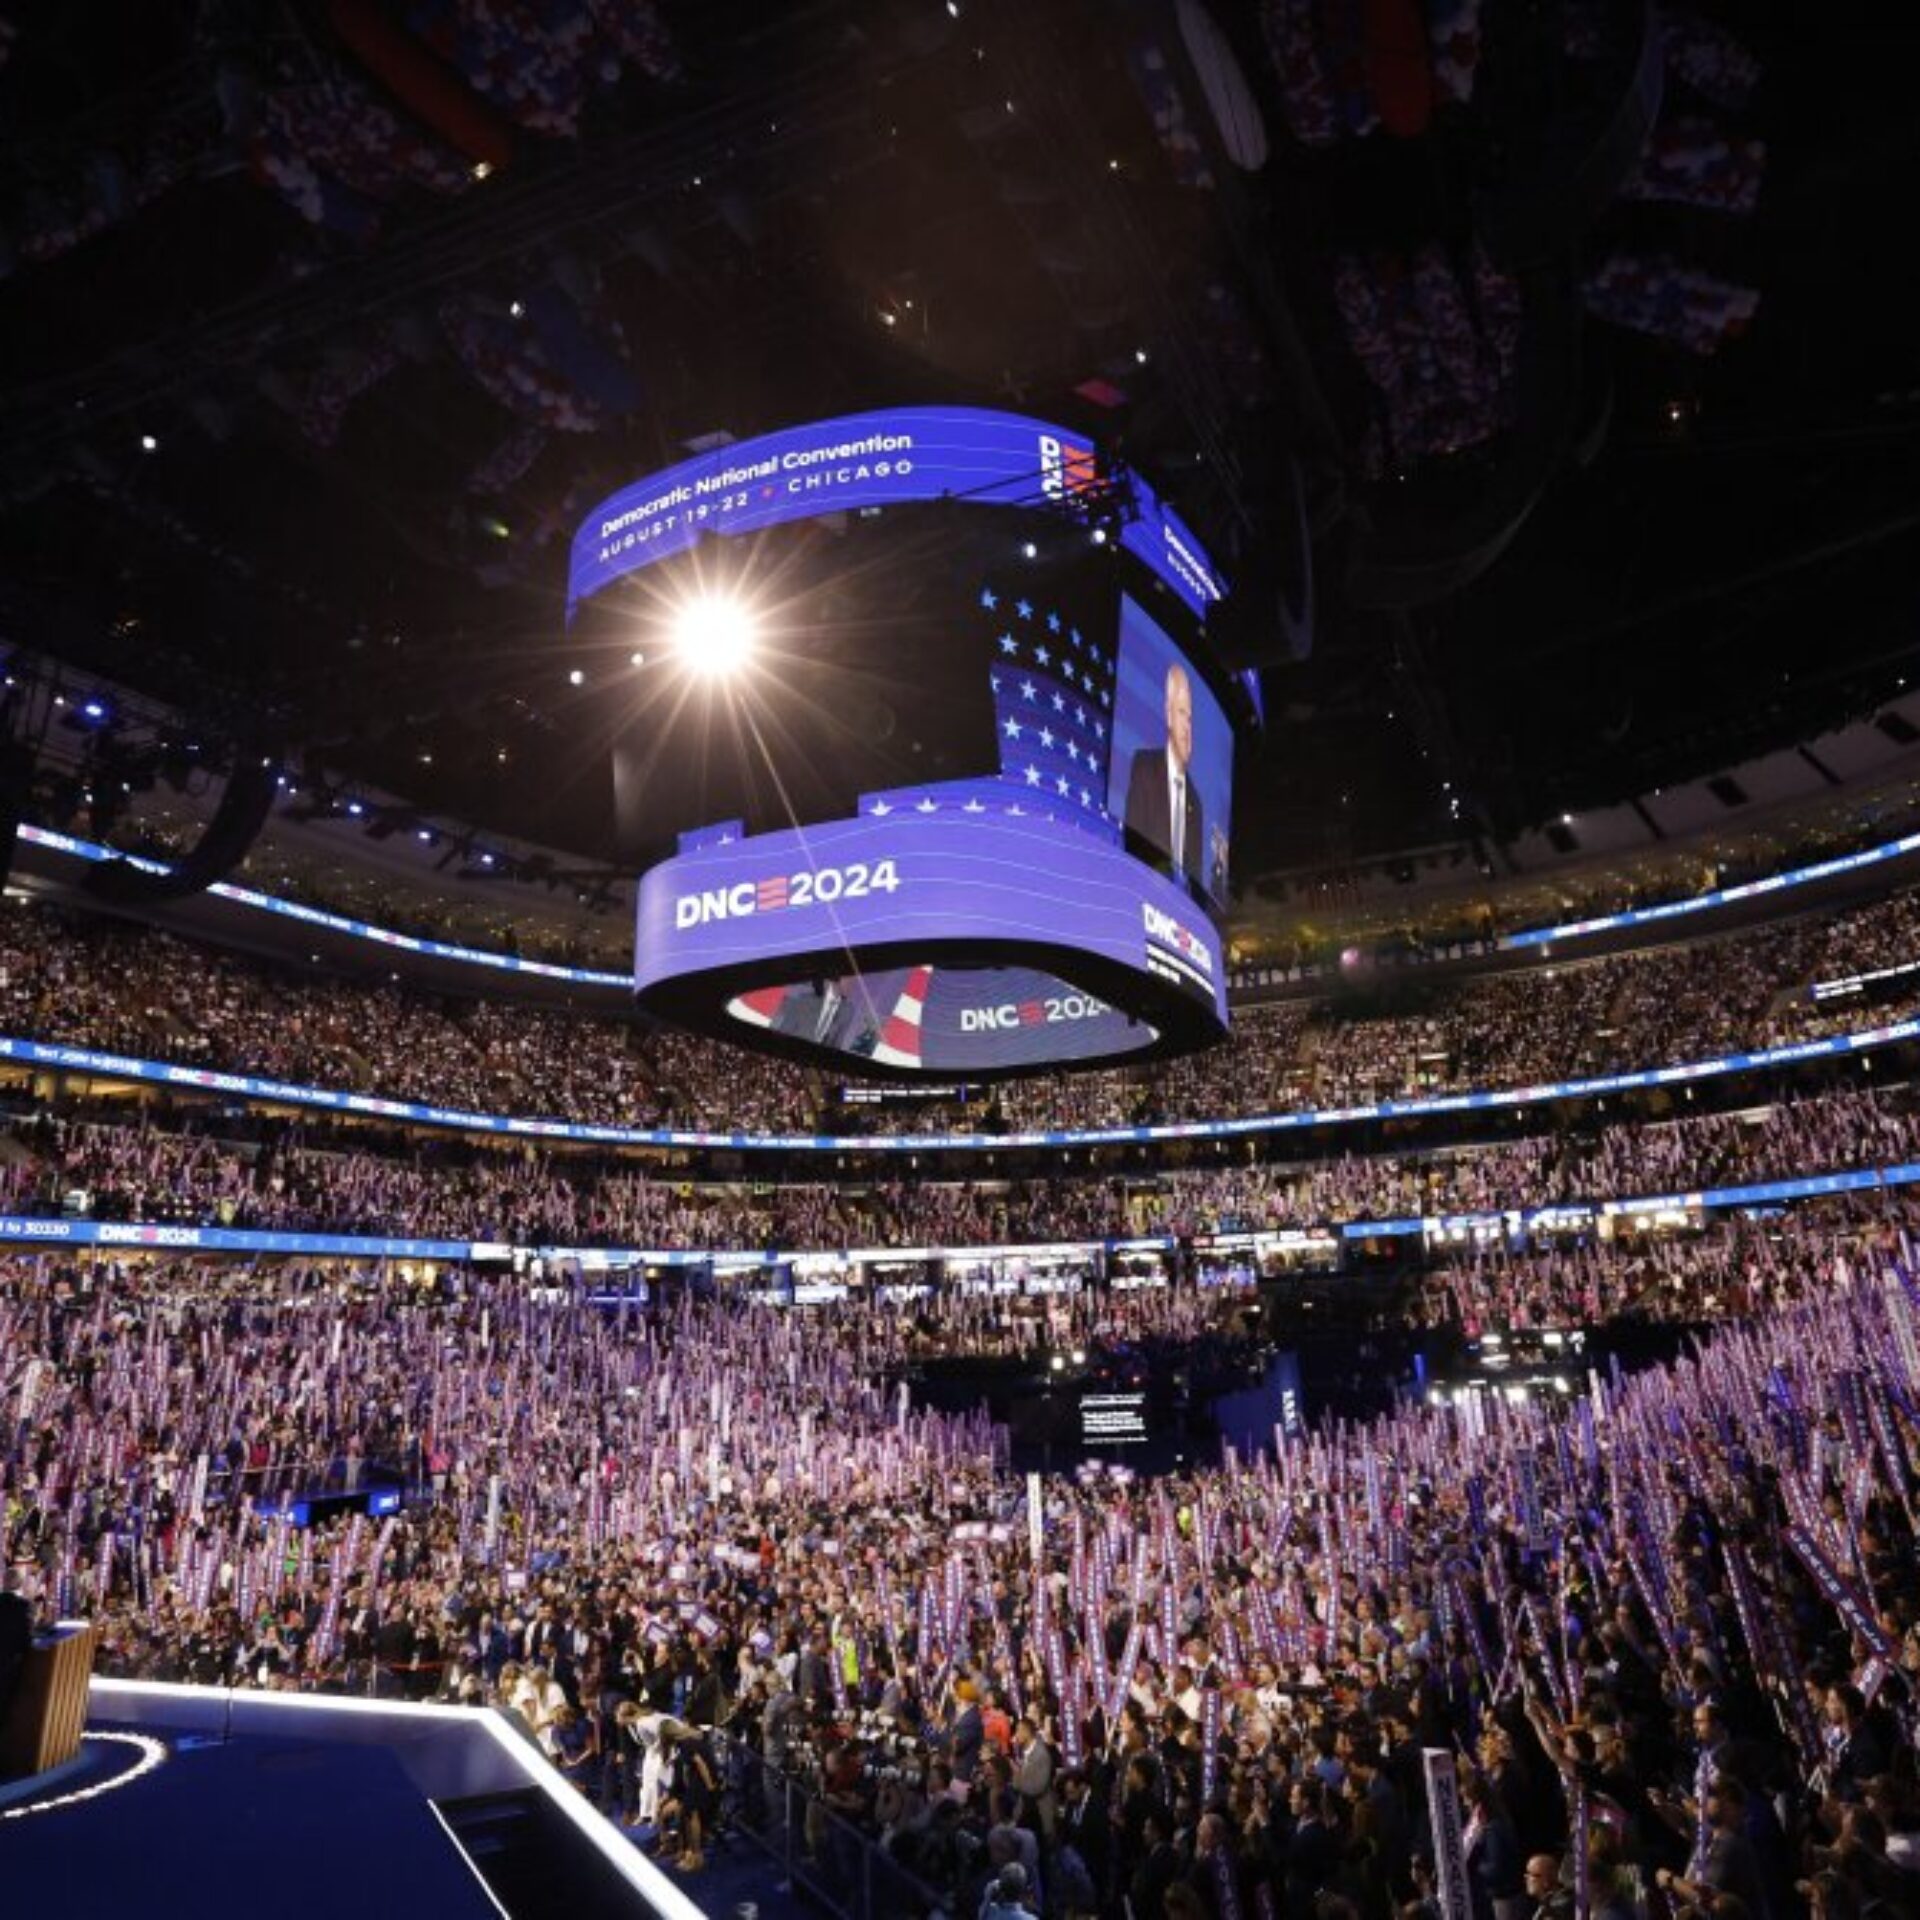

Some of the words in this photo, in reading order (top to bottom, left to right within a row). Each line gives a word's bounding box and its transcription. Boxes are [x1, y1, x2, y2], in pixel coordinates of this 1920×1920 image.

[600, 516, 677, 562] AUGUST
[687, 492, 748, 523] 19-22
[788, 459, 913, 493] CHICAGO
[602, 486, 693, 538] Democratic
[695, 455, 779, 495] National
[782, 433, 912, 469] Convention
[676, 882, 756, 930] DNC
[789, 860, 900, 905] 2024
[960, 1003, 1020, 1032] DNC
